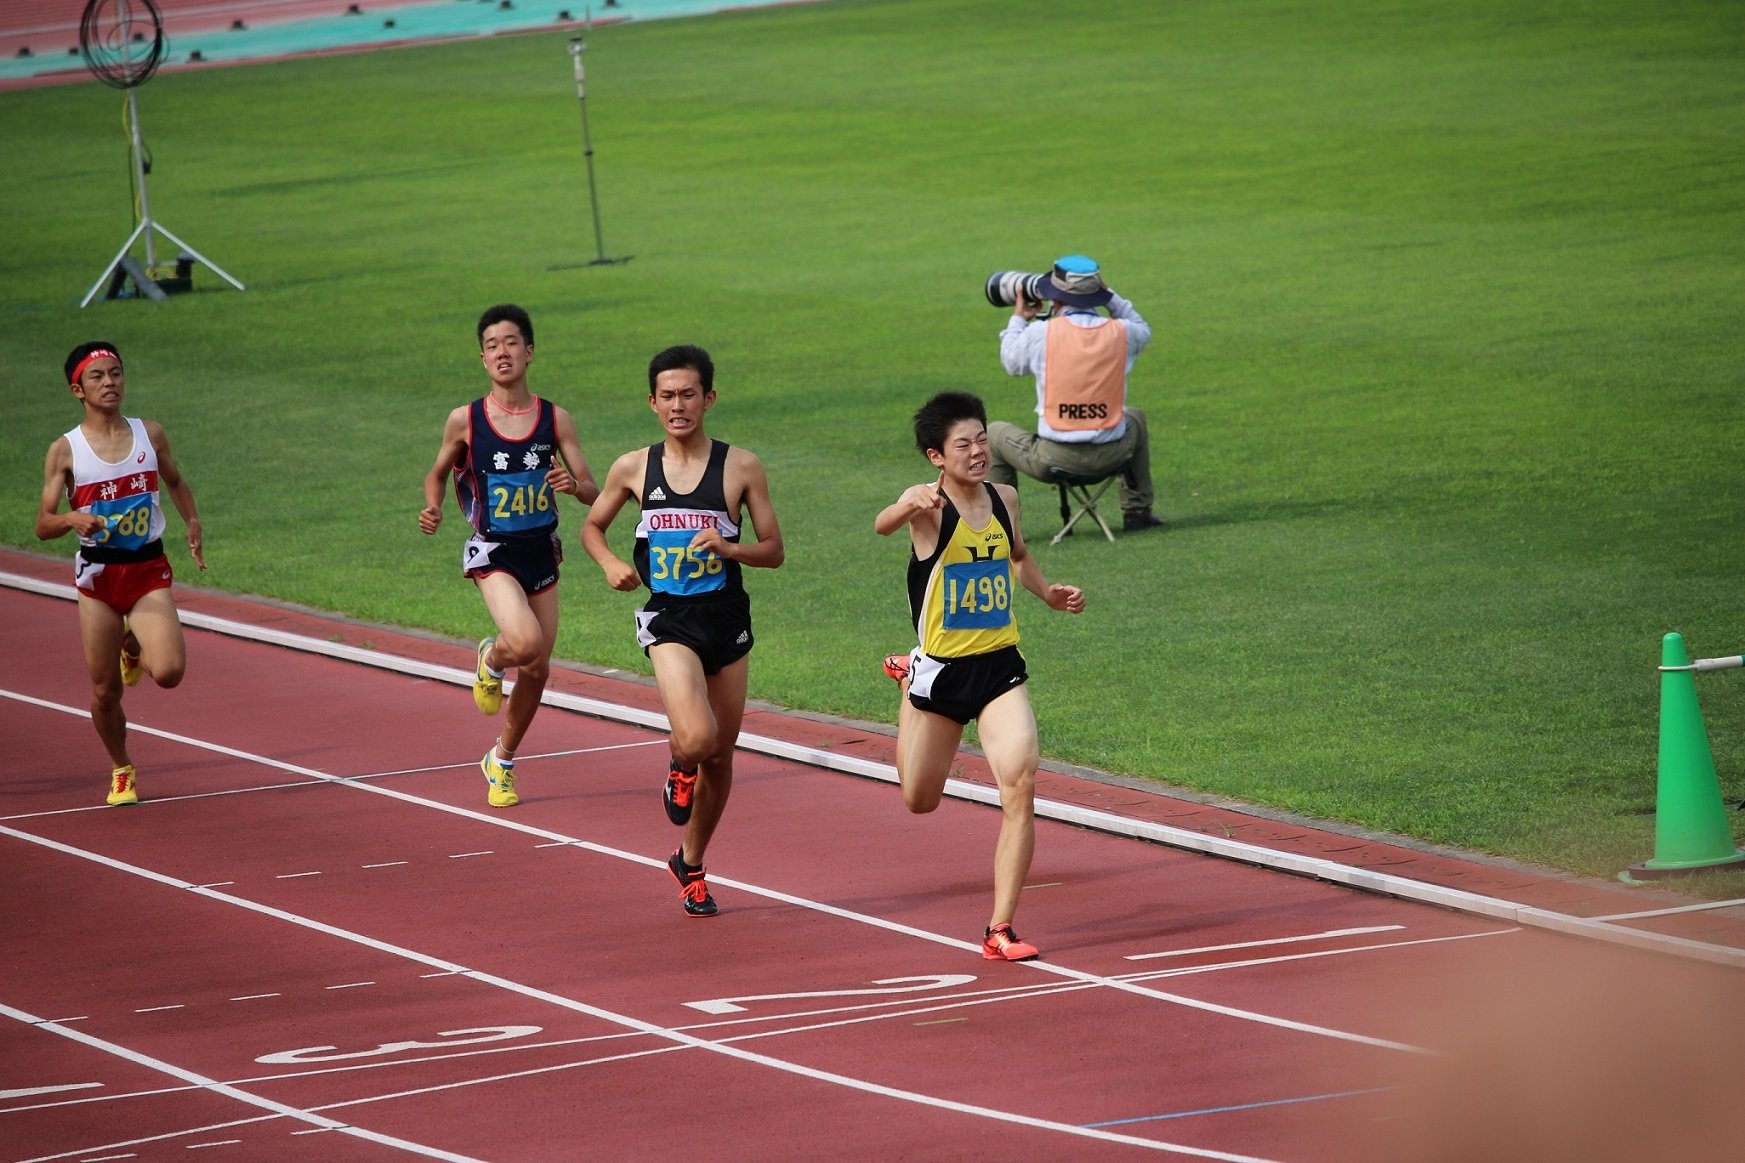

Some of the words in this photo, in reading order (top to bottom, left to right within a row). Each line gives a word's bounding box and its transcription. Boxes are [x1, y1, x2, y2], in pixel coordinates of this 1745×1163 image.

[1058, 402, 1109, 420] PRESS
[492, 481, 550, 519] 2416
[650, 513, 719, 531] OHNUKI
[650, 546, 724, 581] 3756
[948, 574, 1009, 615] 1498
